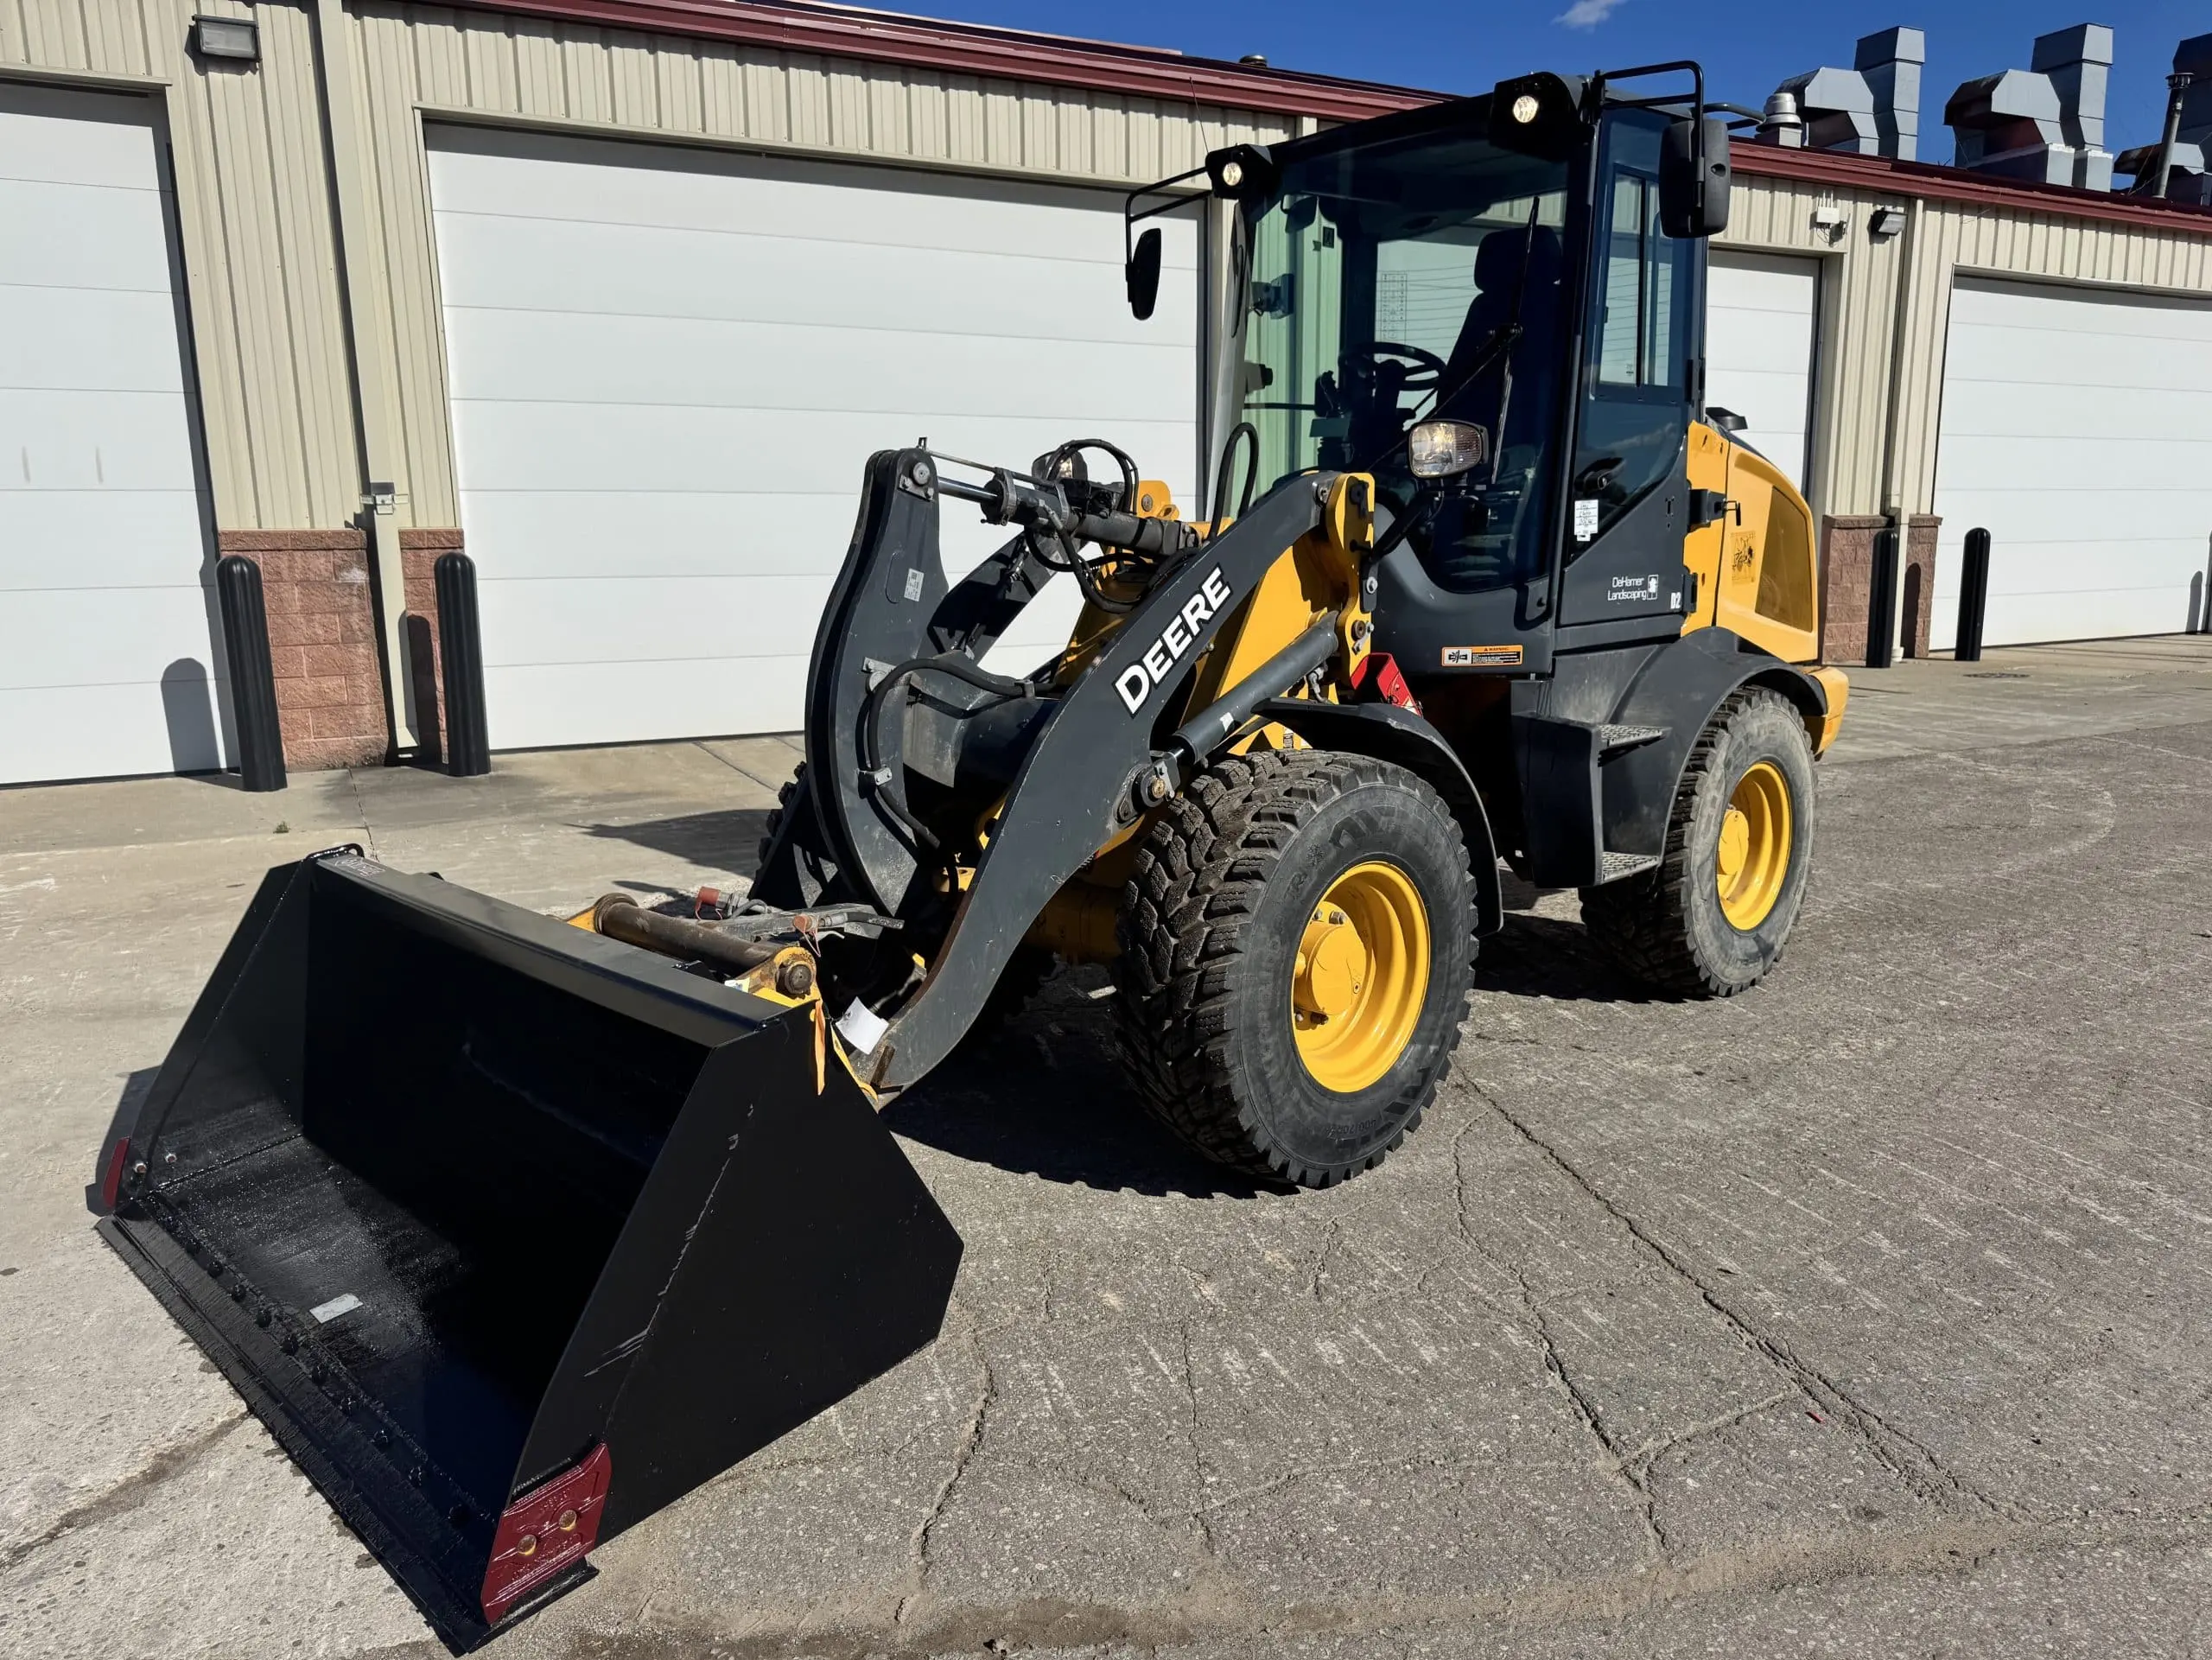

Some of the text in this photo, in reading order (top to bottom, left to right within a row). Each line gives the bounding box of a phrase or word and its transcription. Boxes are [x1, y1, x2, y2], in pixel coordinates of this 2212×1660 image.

[1612, 576, 1644, 588] DeHamer
[1607, 588, 1647, 601] Landscaping
[1115, 567, 1231, 715] DEERE
